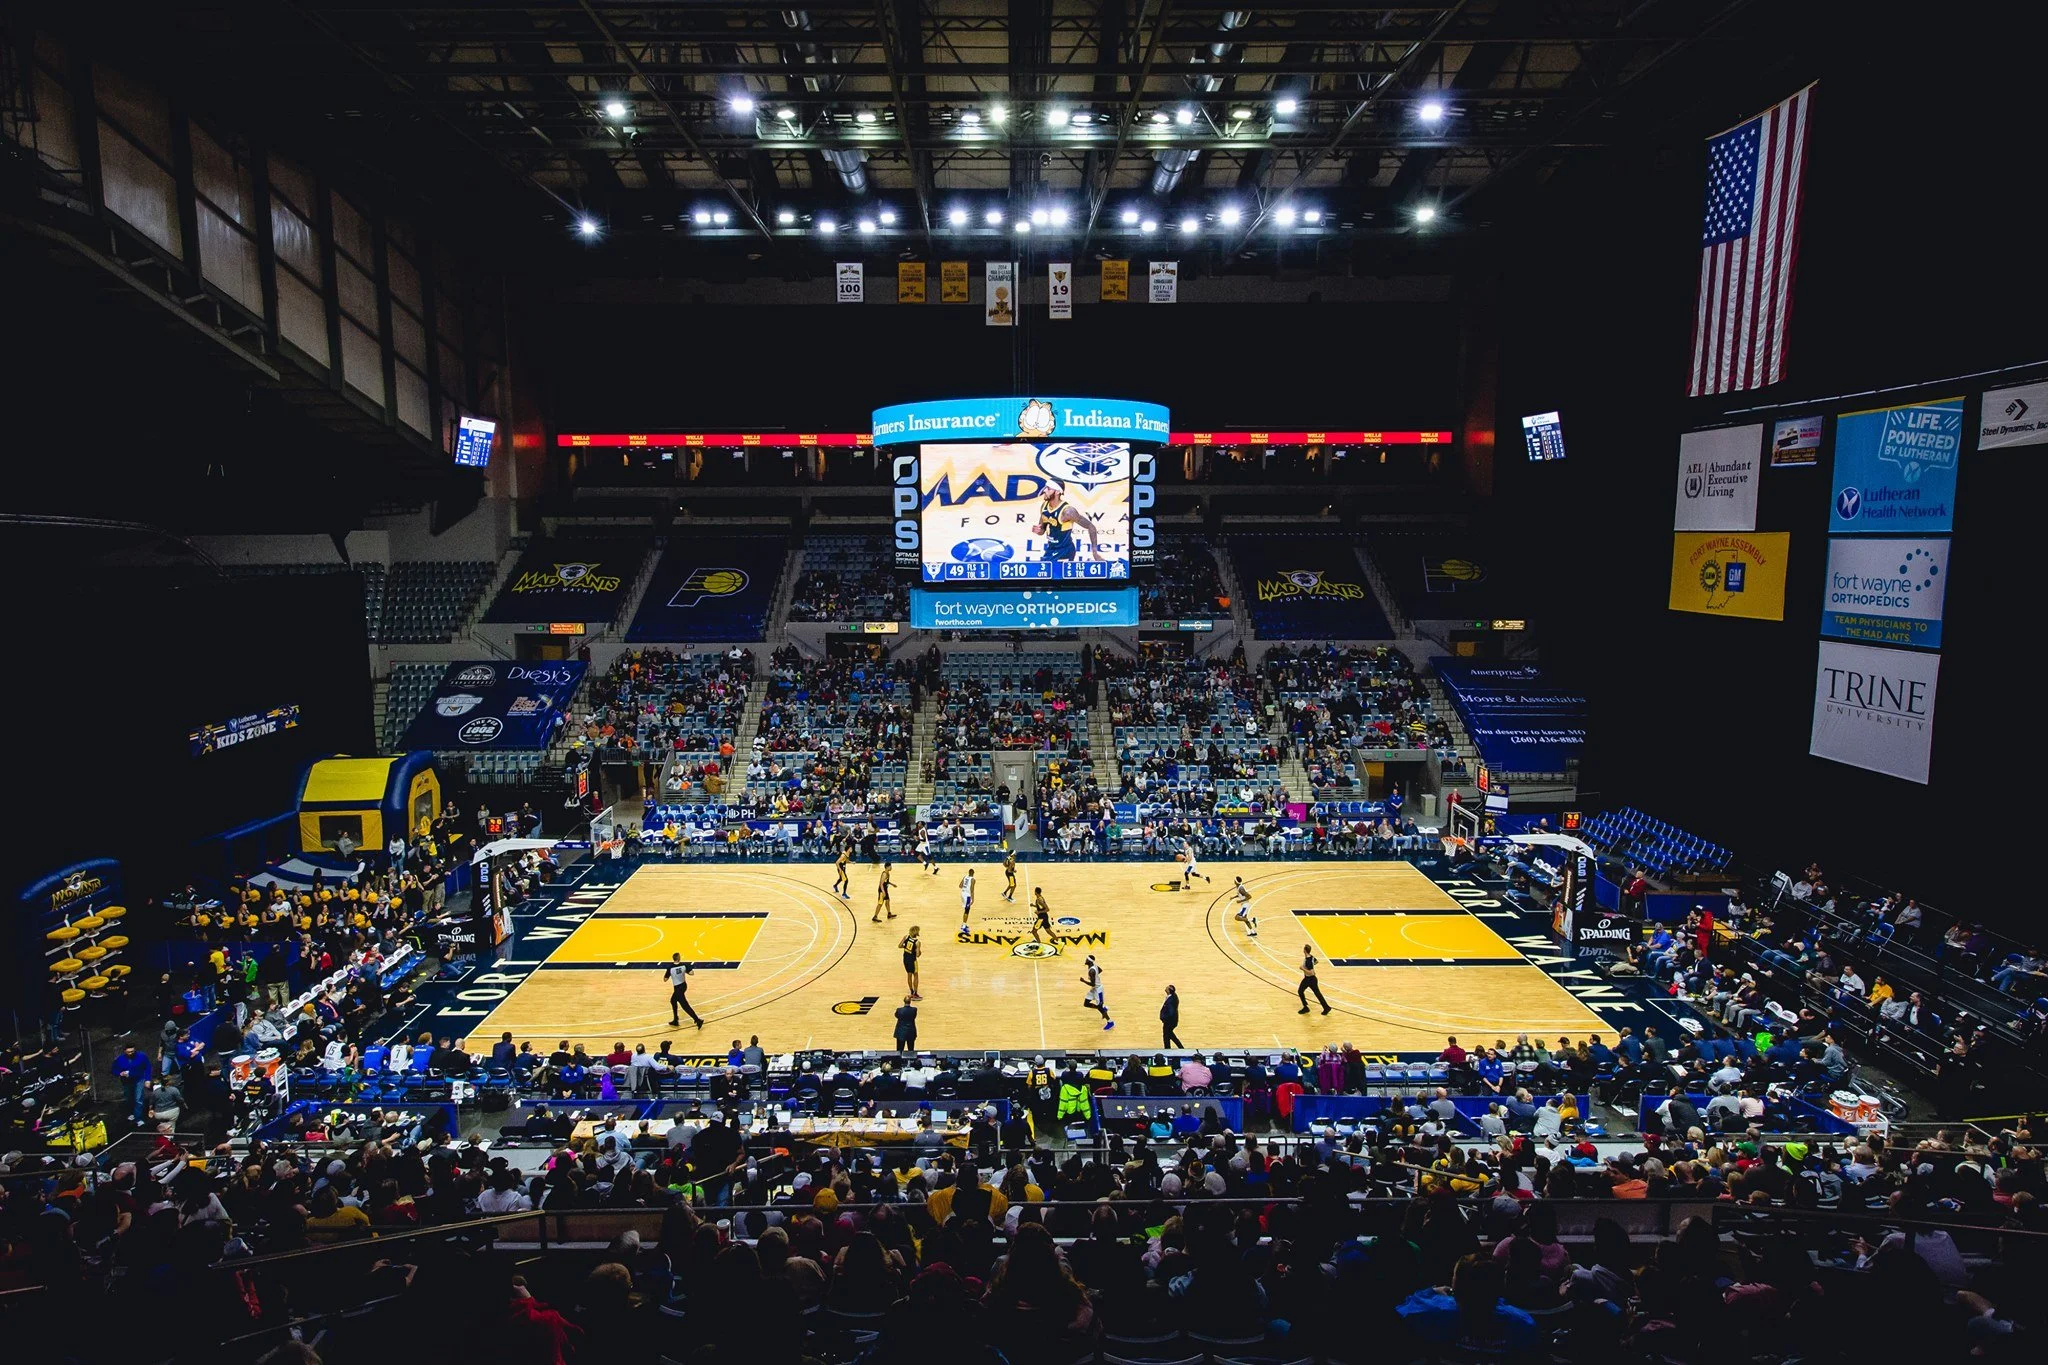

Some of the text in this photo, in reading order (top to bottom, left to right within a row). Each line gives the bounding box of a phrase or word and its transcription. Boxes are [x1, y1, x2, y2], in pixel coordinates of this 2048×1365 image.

[840, 284, 860, 293] 100
[1052, 285, 1069, 295] 19
[873, 413, 996, 437] Farmers Insurance
[1064, 408, 1169, 434] Indiana Farmers
[1907, 412, 1942, 430] LIFE.
[1982, 426, 1999, 437] Steel
[2000, 423, 2035, 435] Dynamics,
[1887, 430, 1955, 450] POWERED
[1884, 445, 1951, 463] BY LUTHERAN
[1686, 460, 1752, 474] AEL Abundant
[1707, 473, 1748, 485] Executive
[1707, 486, 1734, 498] Living
[1864, 486, 1920, 502] Lutheran
[892, 455, 919, 550] OPS
[1132, 453, 1156, 548] OPS
[1862, 503, 1946, 519] Health Network
[961, 513, 1025, 527] FOR
[1689, 537, 1767, 567] FORT WAYNE ASSEMBLY
[949, 565, 964, 576] 49
[1001, 563, 1046, 577] 9:10 3
[1089, 564, 1101, 575] 61
[1728, 568, 1742, 581] GM
[512, 571, 621, 593] MAD ANTS
[1833, 571, 1911, 595] fort wayne
[1257, 579, 1364, 602] MAD ANTS
[1831, 592, 1910, 608] ORTHOPEDICS
[934, 600, 1117, 618] fort wayne ORTHOPEDICS
[935, 618, 982, 626] fwortho.com
[1834, 615, 1928, 633] TEAM PHYSICIANS TO
[1845, 628, 1861, 637] THE
[1863, 629, 1883, 639] MAD
[1470, 669, 1523, 677] Ameriprise
[1459, 694, 1586, 704] Moore & Associates
[1824, 667, 1926, 716] TRINE
[1826, 704, 1925, 731] UNIVERSITY
[216, 721, 277, 749] KID'S ZONE
[1510, 736, 1537, 744] (260)
[741, 808, 756, 818] PH
[490, 824, 500, 832] 22
[1566, 820, 1577, 828] 22
[1434, 879, 1520, 920] FORT
[522, 882, 621, 941] WAYNE
[957, 932, 1022, 946] ANTS
[1580, 928, 1631, 940] SPALDING
[1505, 934, 1645, 1012] WAYNE
[436, 958, 542, 1016] FORT
[328, 1046, 337, 1055] 15
